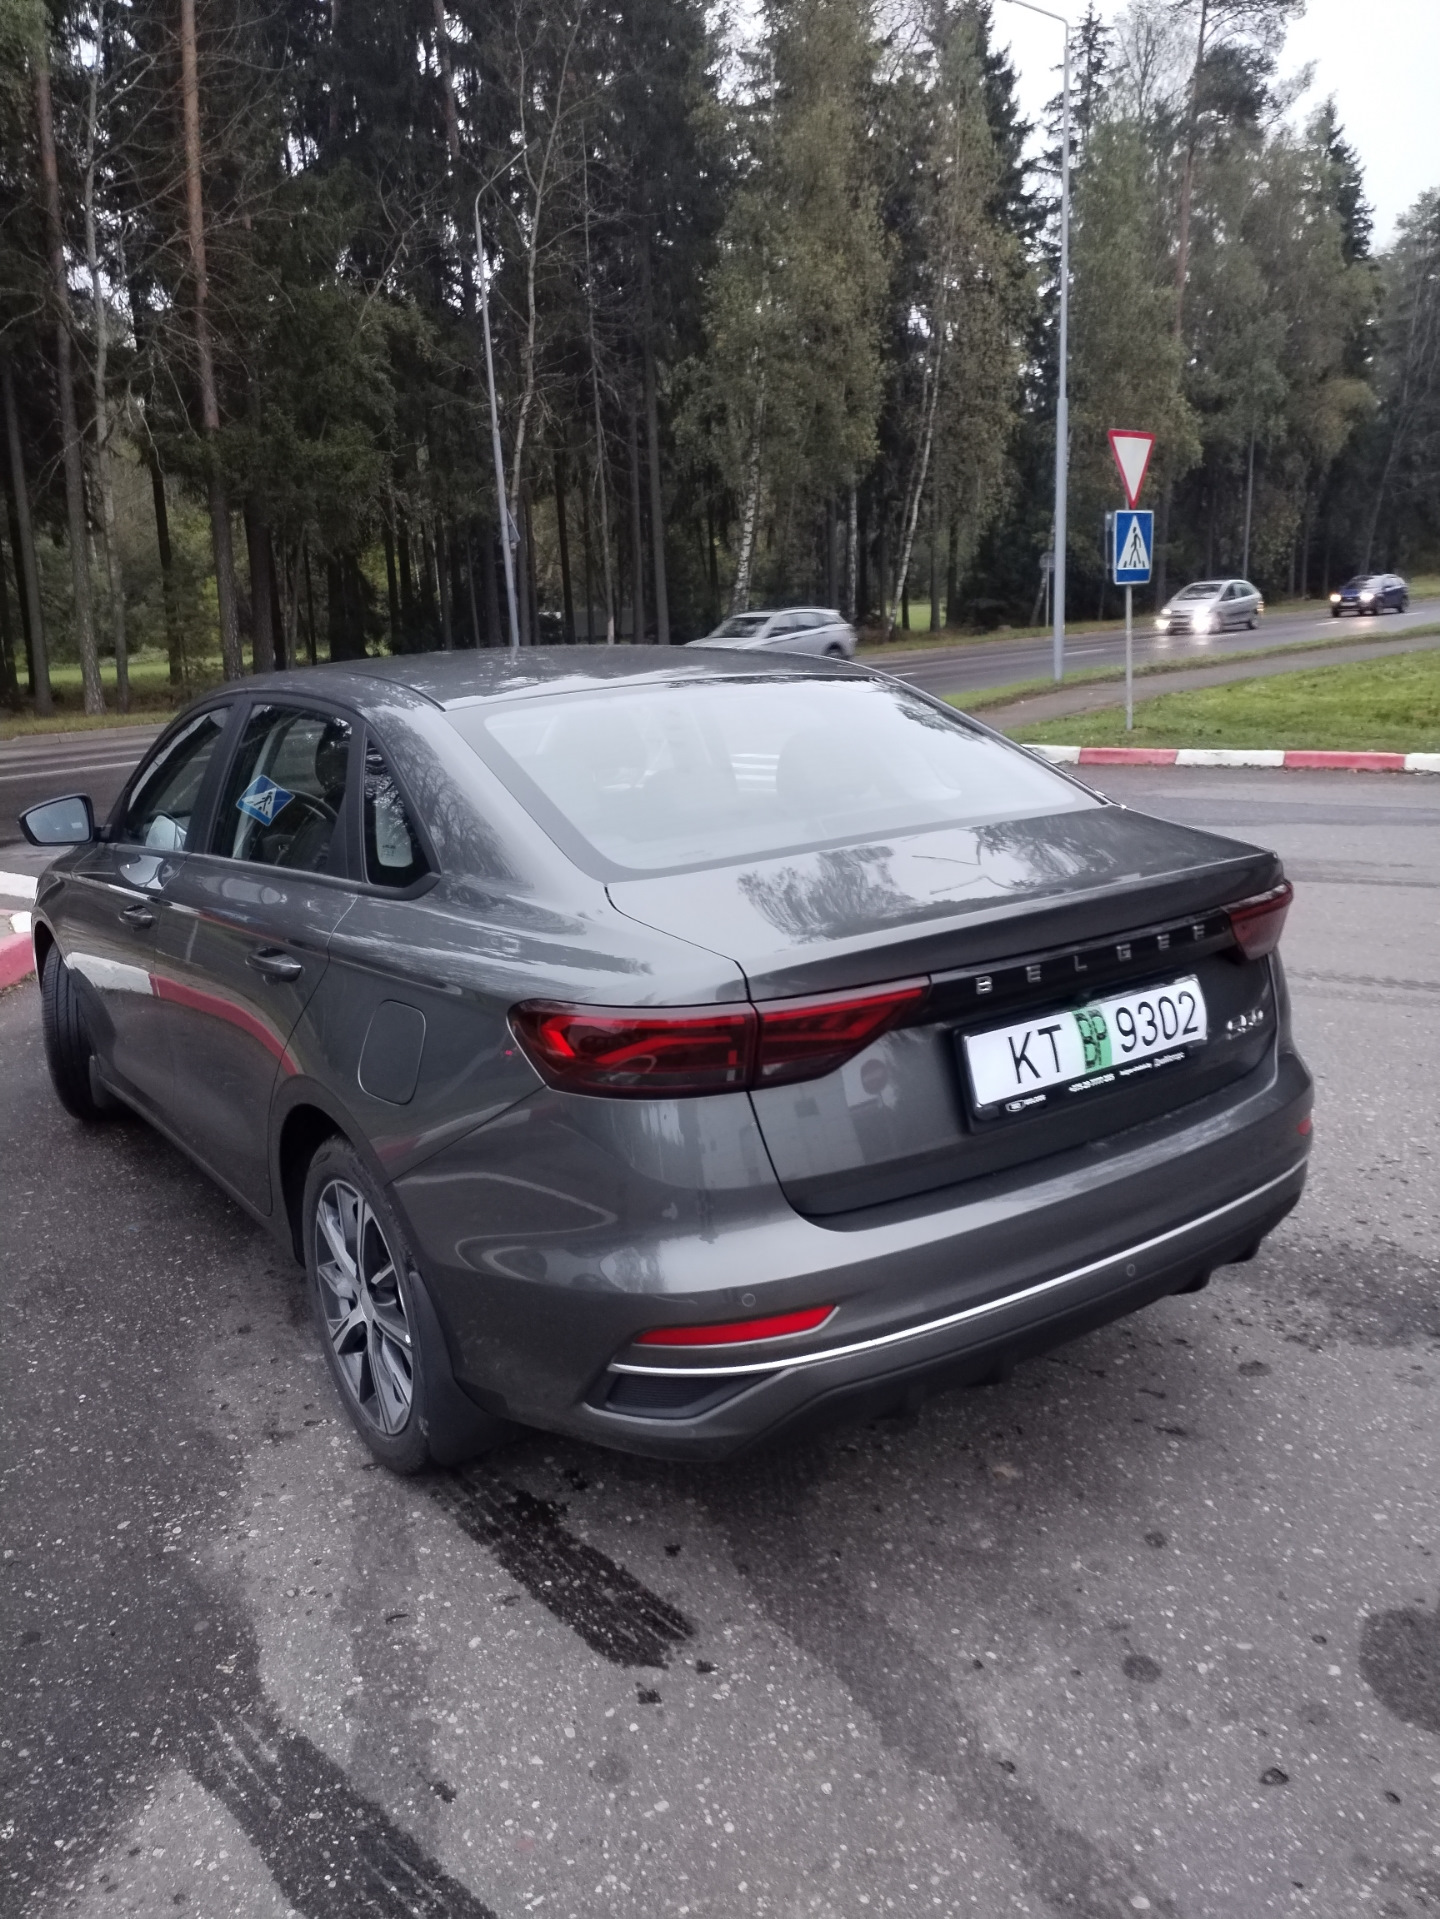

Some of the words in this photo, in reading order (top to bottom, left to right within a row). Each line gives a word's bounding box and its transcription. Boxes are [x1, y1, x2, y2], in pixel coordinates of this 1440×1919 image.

[975, 924, 1205, 995] BELGEE
[1006, 1023, 1063, 1084] KT
[1115, 990, 1199, 1053] 9302
